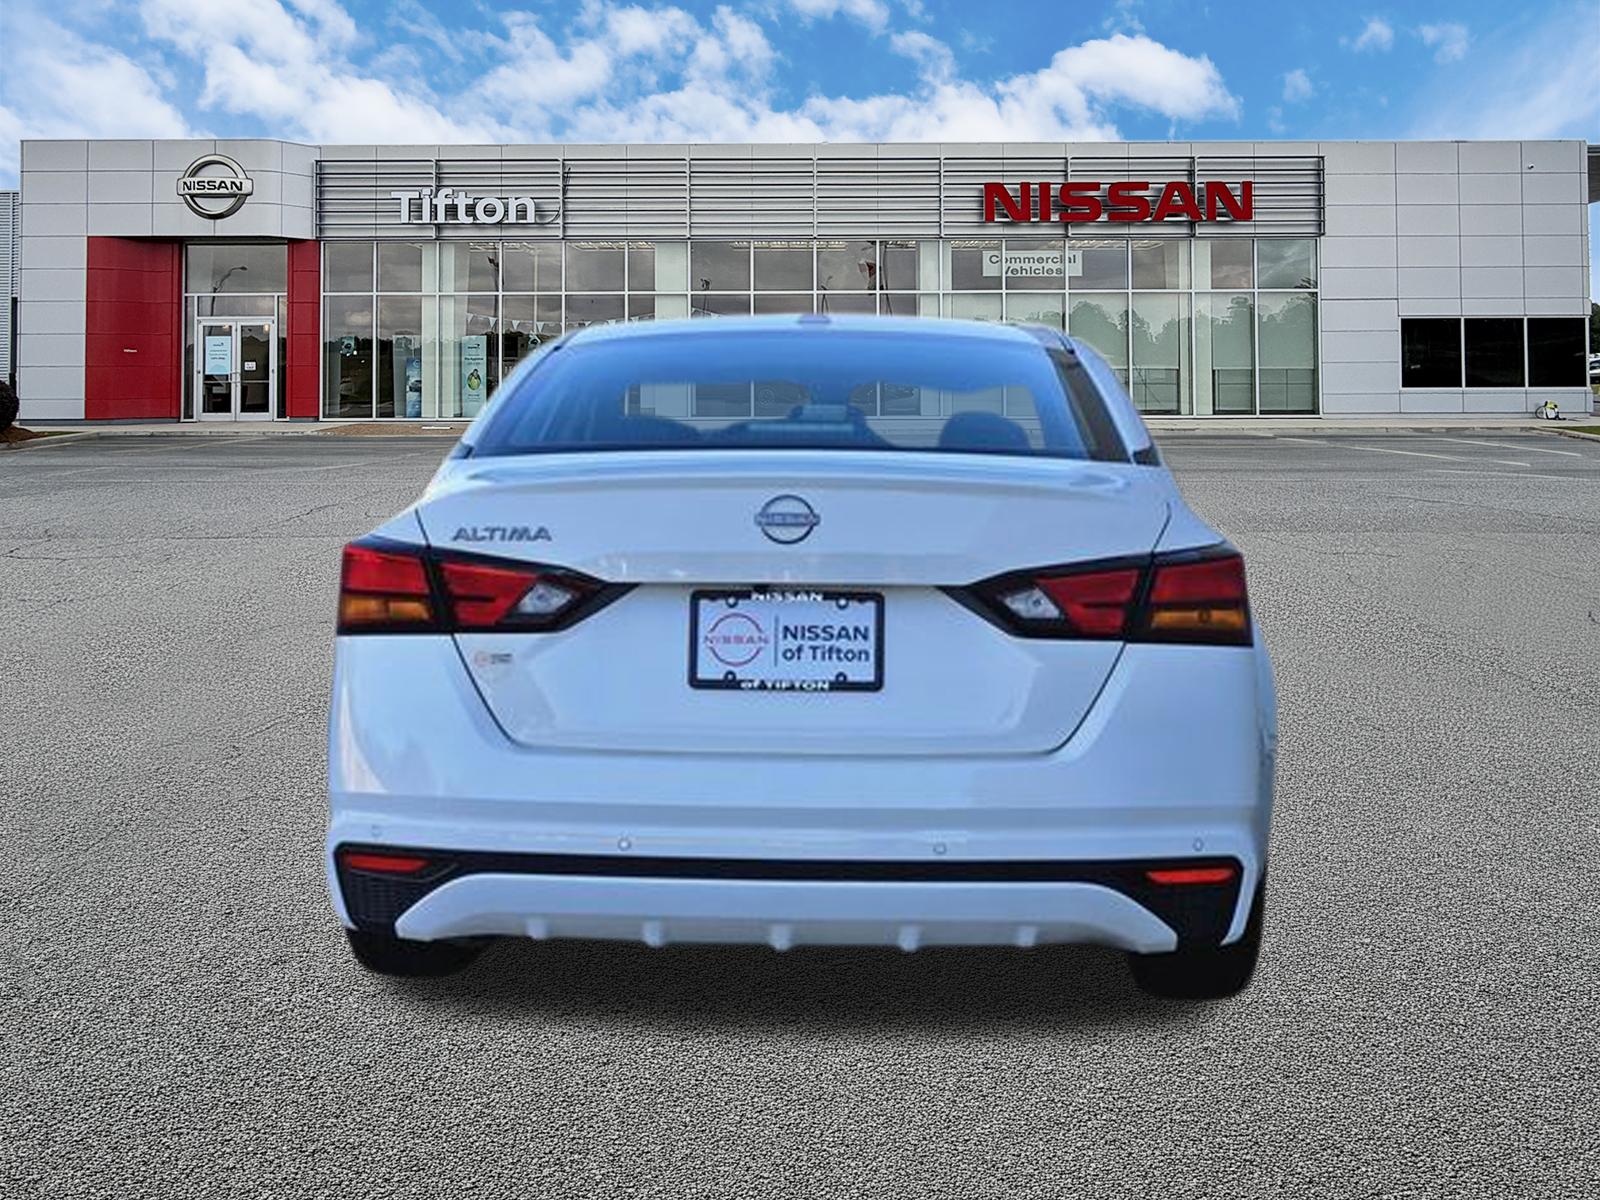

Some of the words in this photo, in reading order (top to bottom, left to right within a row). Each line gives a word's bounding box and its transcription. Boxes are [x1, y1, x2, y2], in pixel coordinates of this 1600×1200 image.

[182, 180, 243, 192] NISSAN
[390, 187, 536, 224] Tifton
[983, 180, 1253, 222] NISSAN
[452, 526, 552, 541] ALTIMA
[751, 592, 822, 601] NISSAN
[782, 625, 869, 642] NISSAN
[782, 644, 803, 662] of
[810, 646, 870, 663] Tifton
